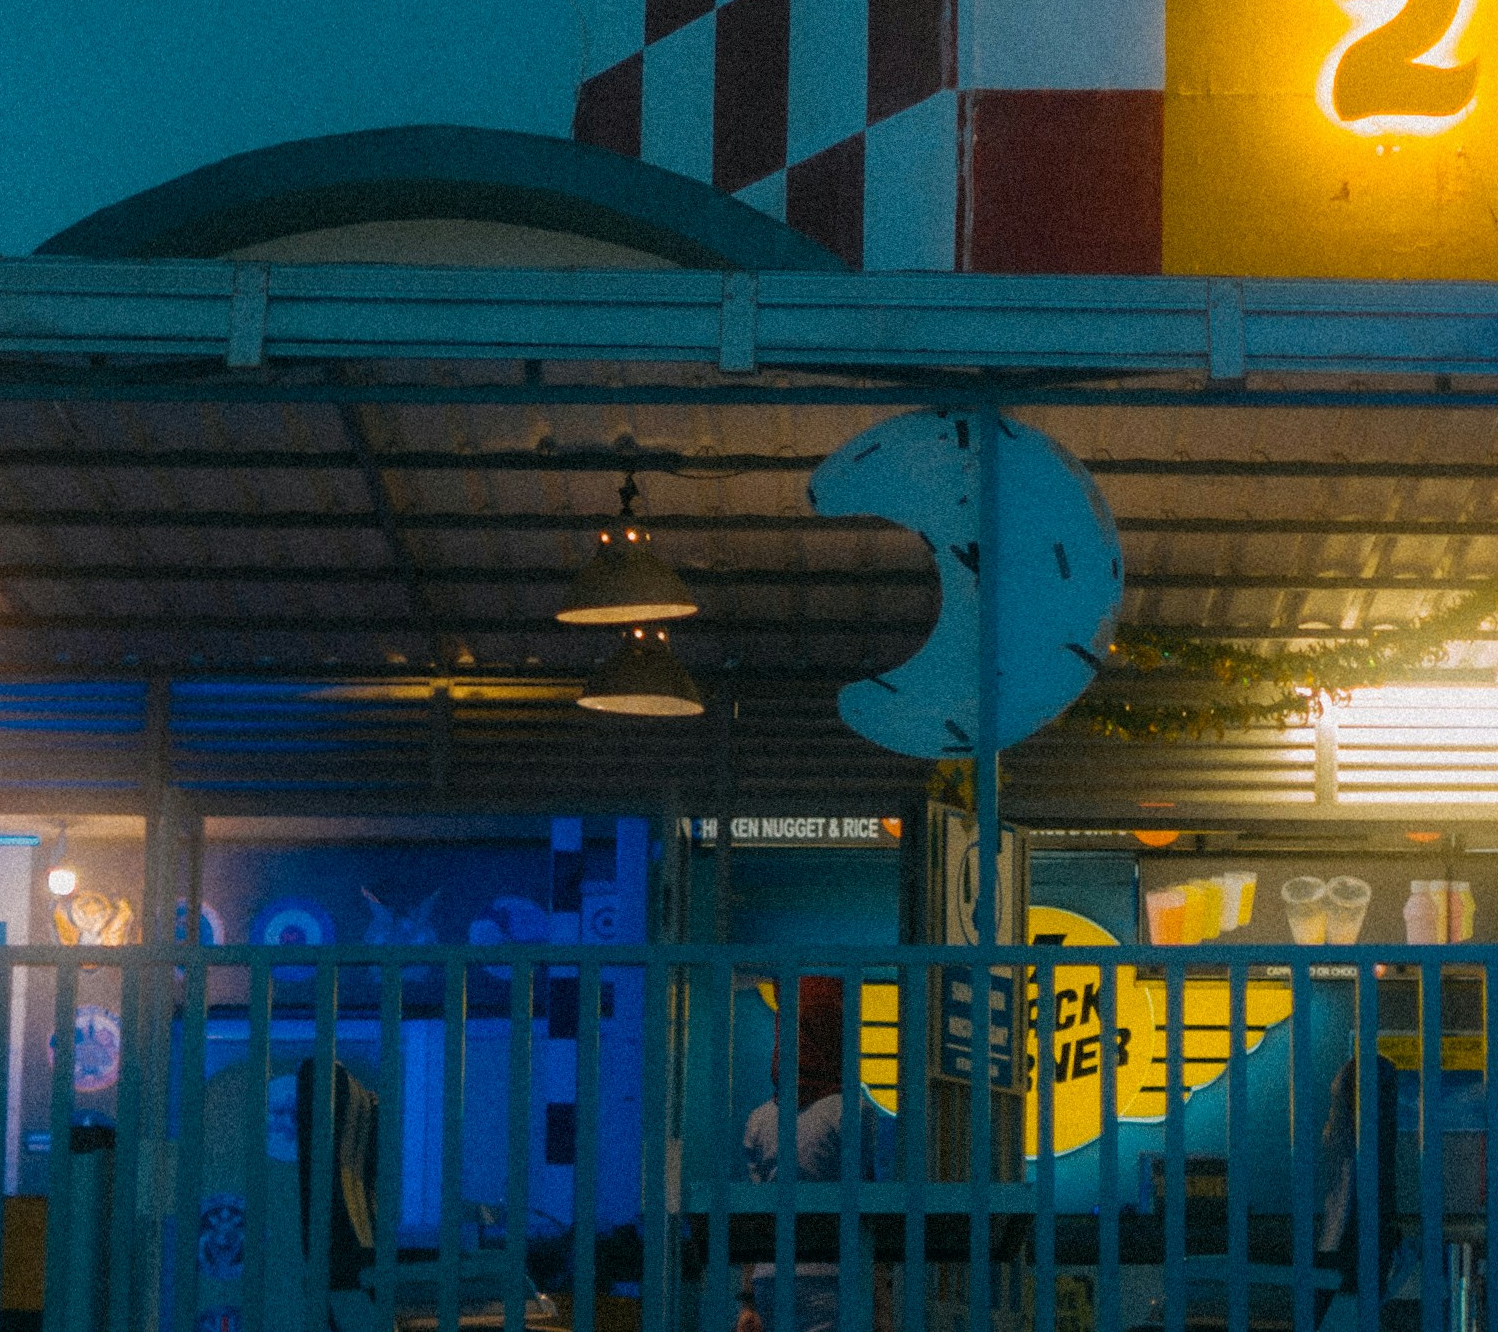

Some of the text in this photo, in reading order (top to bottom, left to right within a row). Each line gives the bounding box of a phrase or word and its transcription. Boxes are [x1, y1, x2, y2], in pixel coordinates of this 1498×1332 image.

[692, 817, 879, 839] CHIKEN NUGGET & RICE
